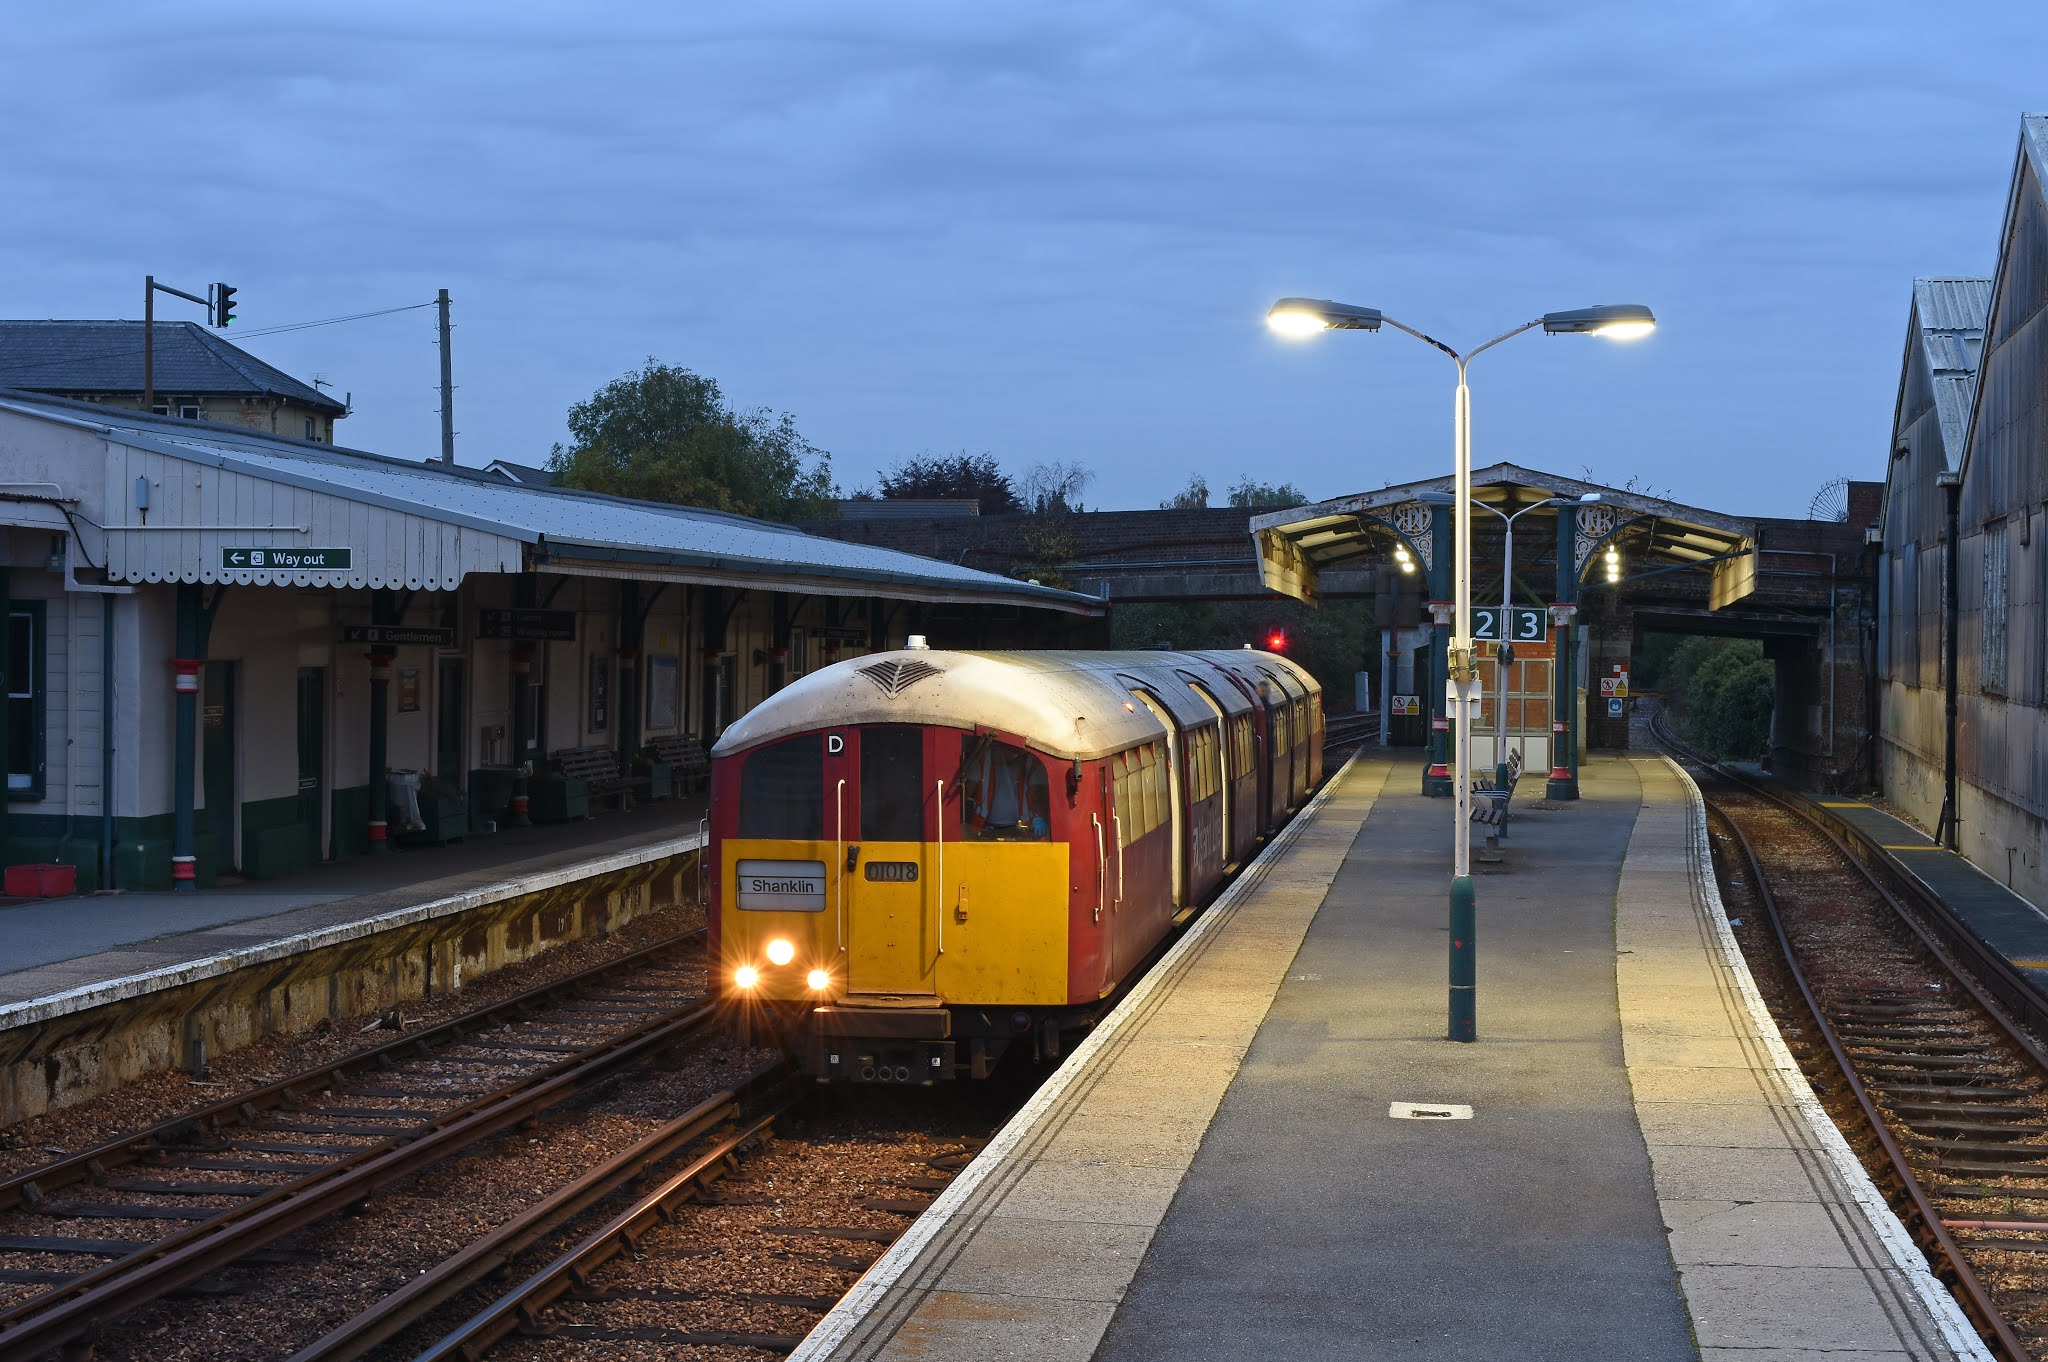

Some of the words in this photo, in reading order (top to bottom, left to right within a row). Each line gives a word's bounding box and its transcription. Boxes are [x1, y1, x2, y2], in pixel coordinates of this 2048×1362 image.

[272, 552, 300, 567] Way
[303, 553, 325, 565] out
[1475, 611, 1493, 637] 2
[1520, 612, 1538, 638] 3
[385, 630, 442, 643] Gentlemen
[828, 735, 844, 753] D
[752, 879, 814, 893] Shanklin
